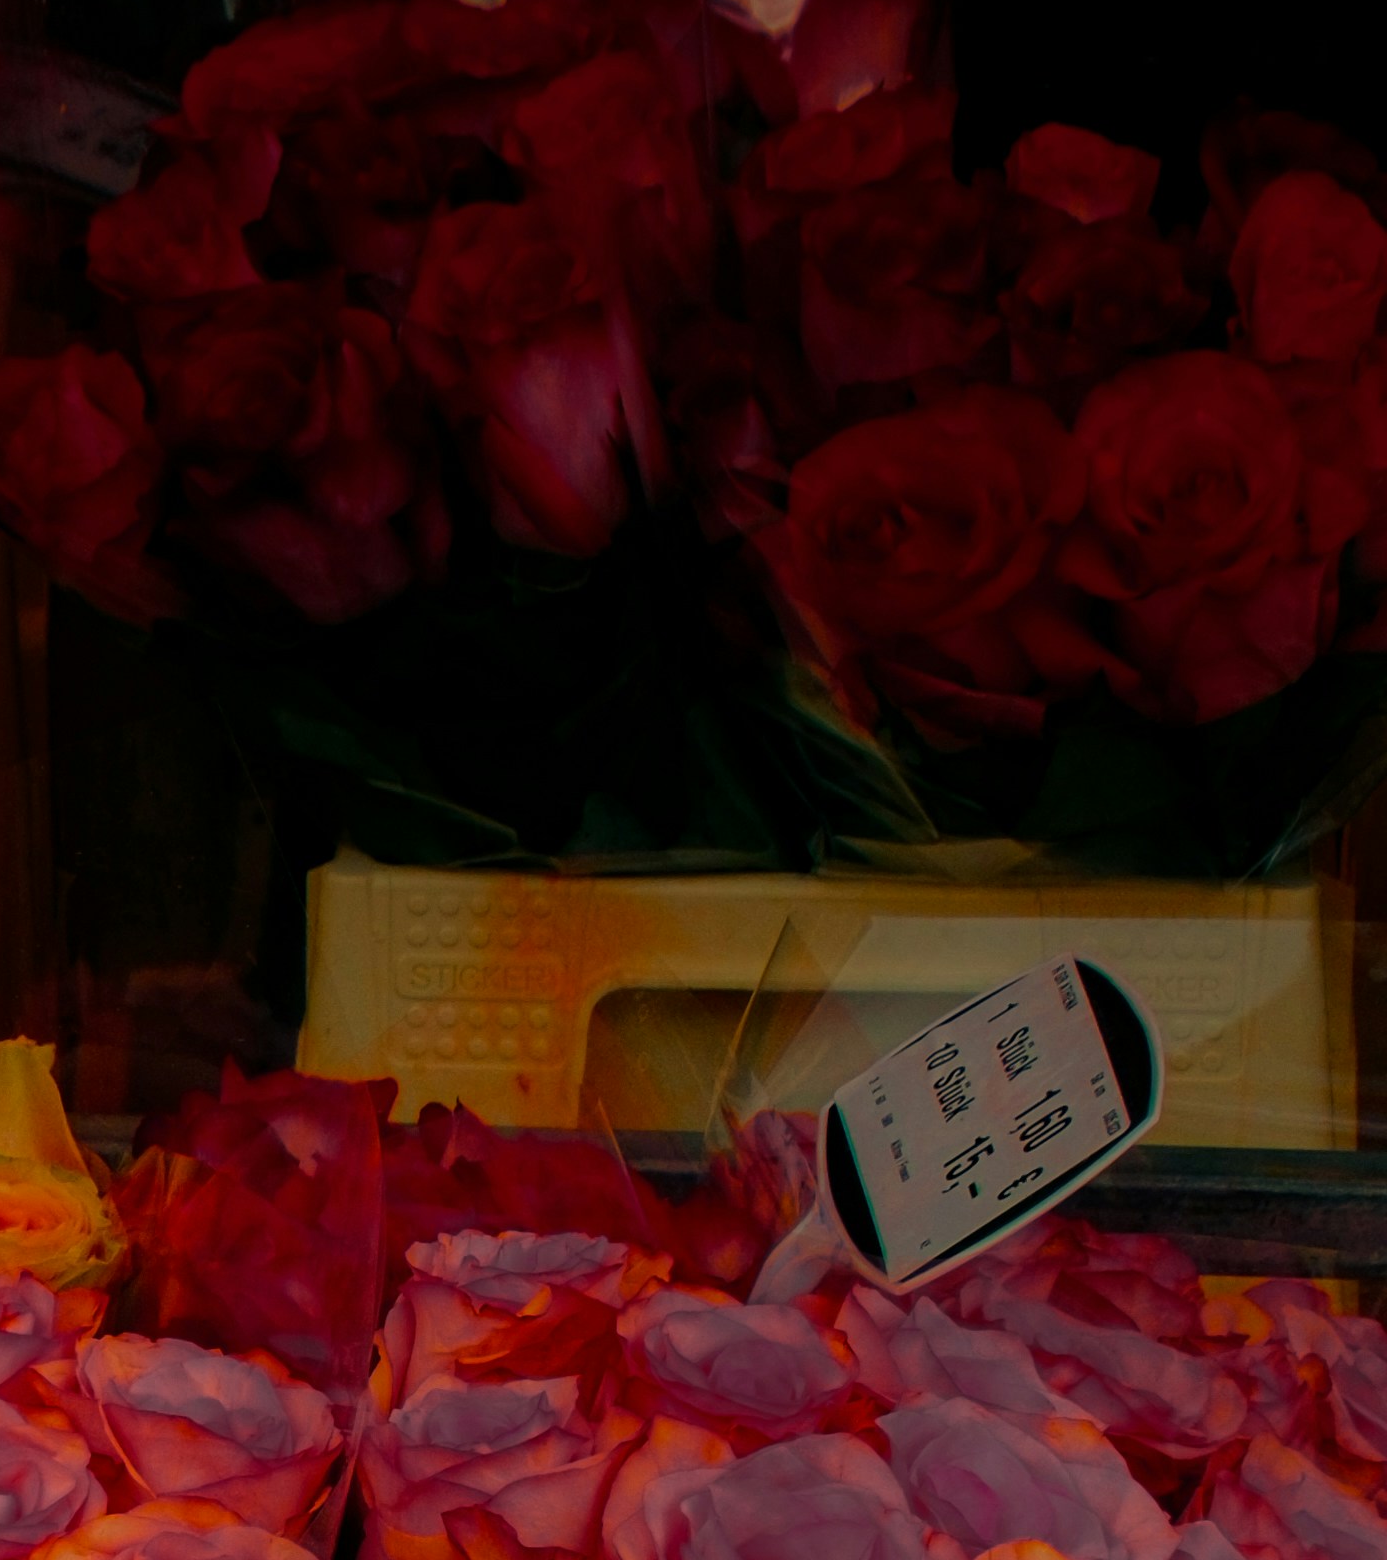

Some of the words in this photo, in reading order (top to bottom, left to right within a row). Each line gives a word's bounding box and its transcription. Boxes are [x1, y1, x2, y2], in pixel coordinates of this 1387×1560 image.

[987, 1002, 1020, 1023] 1
[925, 1041, 959, 1071] 10
[996, 1025, 1039, 1082] Stück
[933, 1065, 975, 1123] Stück
[1009, 1088, 1073, 1153] 1,60
[998, 1166, 1044, 1200] €
